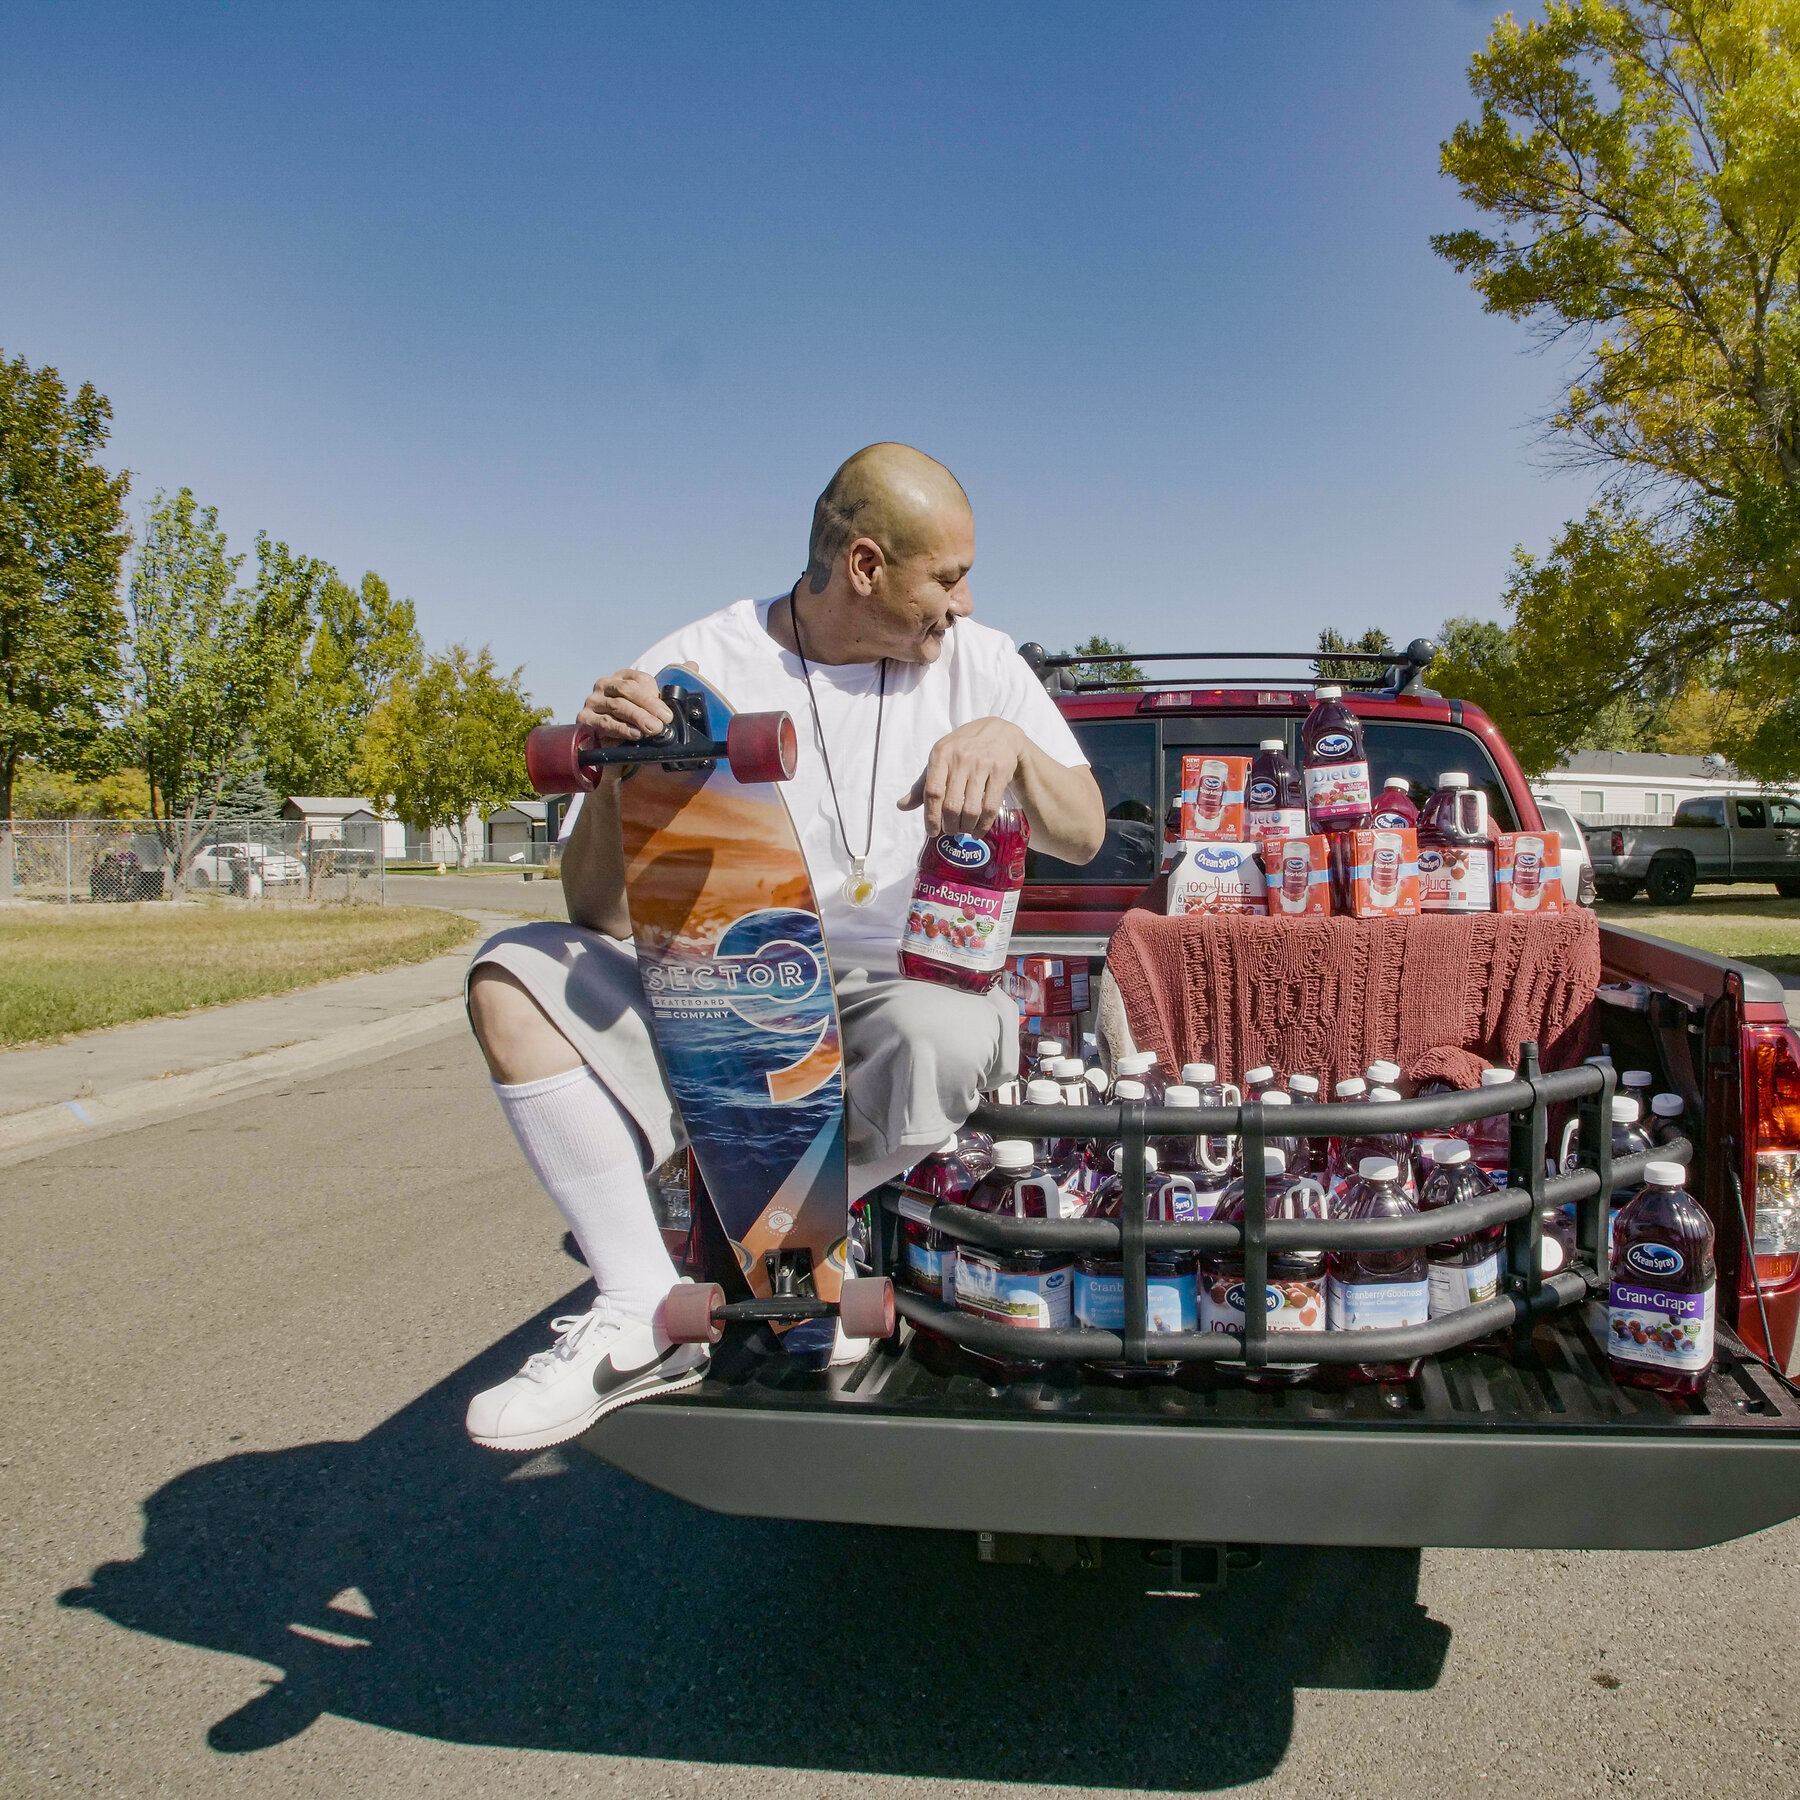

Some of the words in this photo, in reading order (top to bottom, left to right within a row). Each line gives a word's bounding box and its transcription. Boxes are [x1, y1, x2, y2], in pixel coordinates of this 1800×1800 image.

[1320, 742, 1335, 752] Ocean
[1335, 741, 1348, 753] Spray
[1313, 767, 1347, 782] Diet
[941, 839, 961, 857] Ocean
[961, 848, 982, 862] Spray
[1197, 854, 1218, 868] Ocean
[1218, 855, 1239, 870] Spray
[1205, 876, 1251, 904] JUICE
[1420, 873, 1452, 902] JUICE
[646, 961, 805, 991] SECTOR
[654, 998, 725, 1006] SKATEBOARD
[673, 1010, 729, 1019] COMPANY
[1175, 1200, 1190, 1211] Spray
[1632, 1251, 1654, 1267] Ocean
[1654, 1256, 1675, 1271] Spray
[1089, 1281, 1125, 1292] Cranb
[1346, 1289, 1385, 1300] Cranberry
[1387, 1288, 1423, 1297] Goodness
